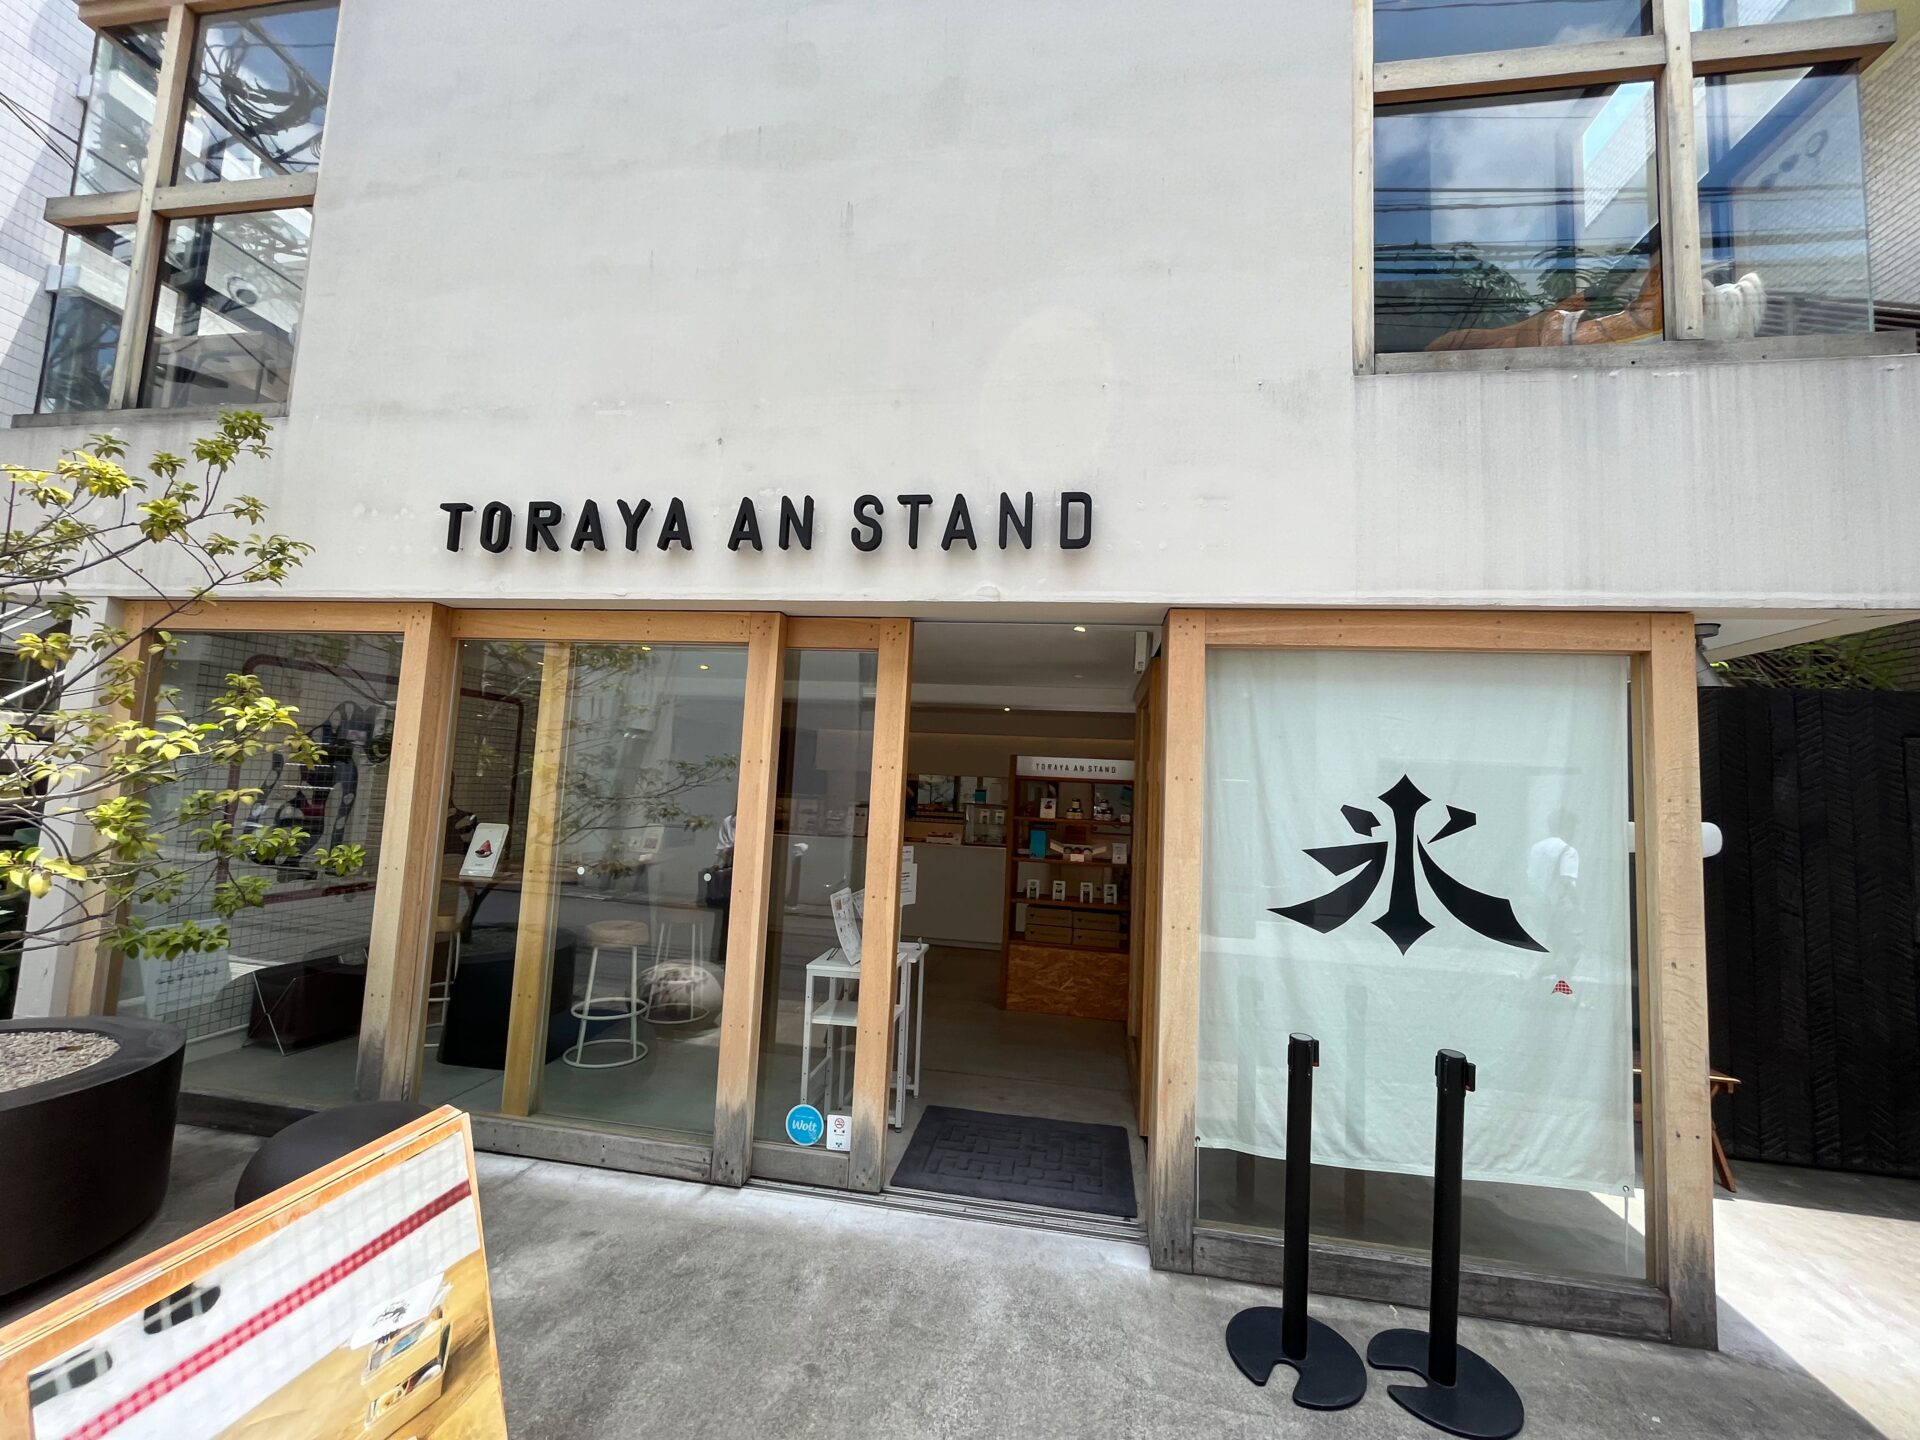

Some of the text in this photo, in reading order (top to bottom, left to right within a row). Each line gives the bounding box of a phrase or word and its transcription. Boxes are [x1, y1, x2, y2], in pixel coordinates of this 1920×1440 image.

[440, 491, 1092, 553] TORAYA AN STAND
[1035, 763, 1117, 774] TORAYA AN STAND
[1266, 773, 1550, 957] 氷
[792, 1119, 817, 1132] Wolt
